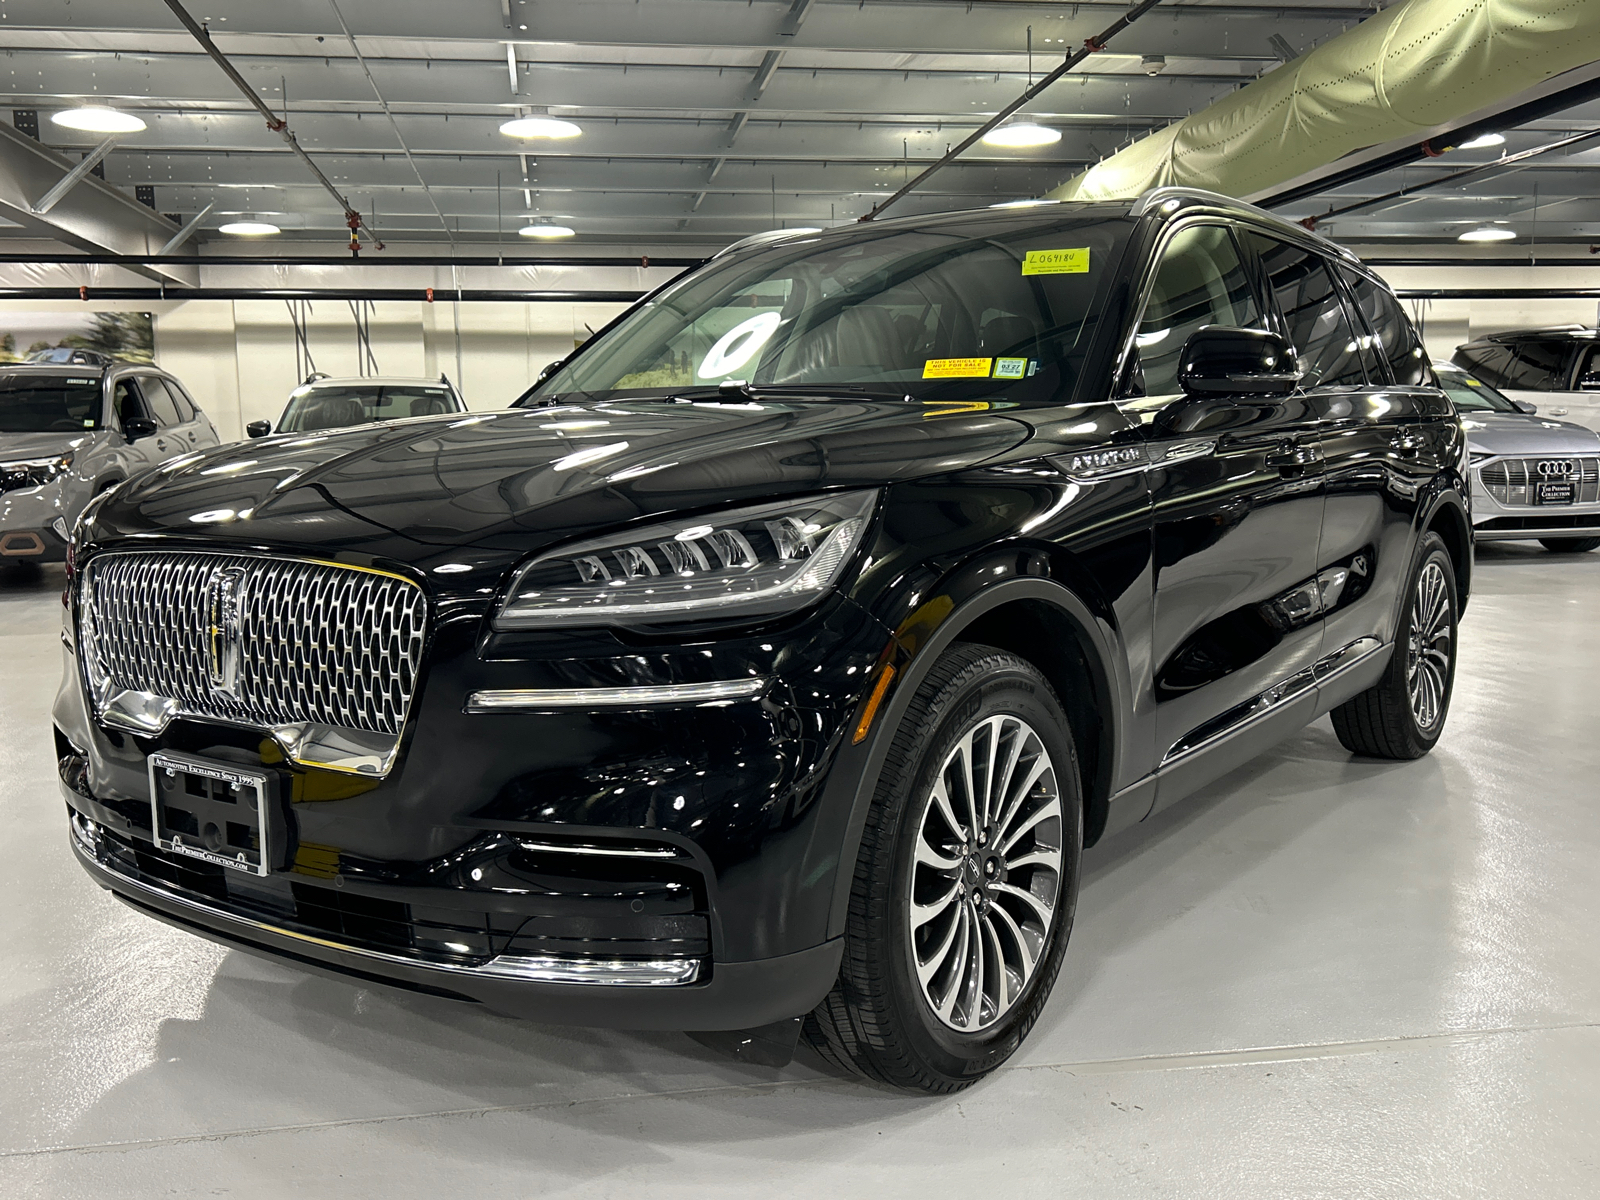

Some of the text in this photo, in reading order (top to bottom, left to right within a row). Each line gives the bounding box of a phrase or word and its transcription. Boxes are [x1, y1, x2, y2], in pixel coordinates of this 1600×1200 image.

[1071, 448, 1140, 470] AVIATOR
[221, 770, 238, 782] SINCE
[238, 775, 255, 786] 1995
